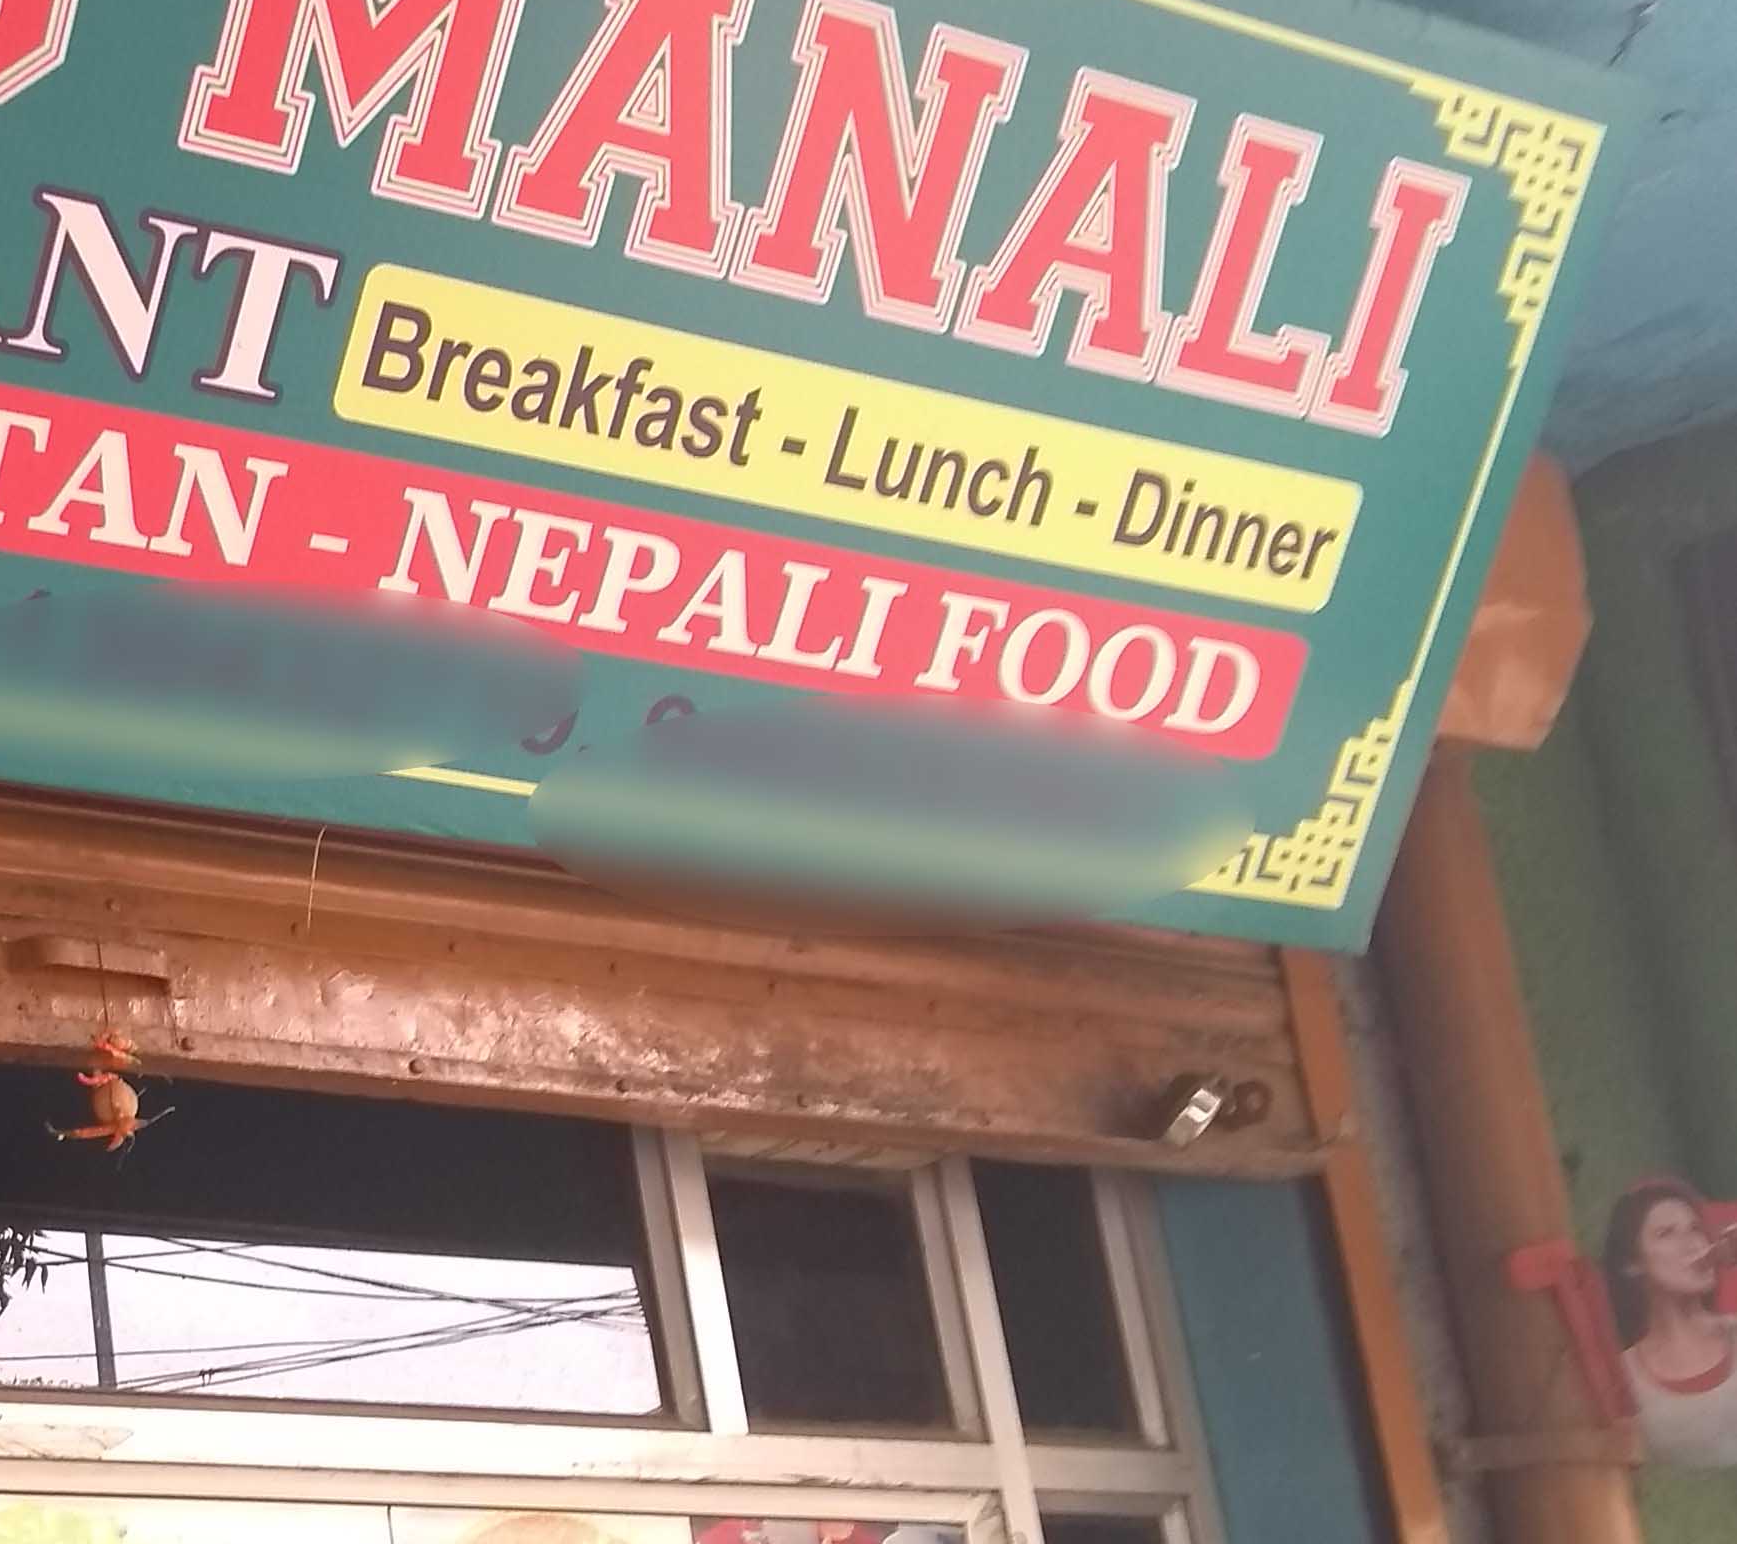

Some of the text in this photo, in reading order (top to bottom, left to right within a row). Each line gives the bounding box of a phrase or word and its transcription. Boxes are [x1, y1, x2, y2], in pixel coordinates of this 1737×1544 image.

[361, 302, 763, 470] Breakfast
[824, 403, 1054, 531] Lunch
[1113, 466, 1339, 583] Dinner
[383, 487, 926, 678] NEPALI
[915, 609, 1263, 740] FOOD
